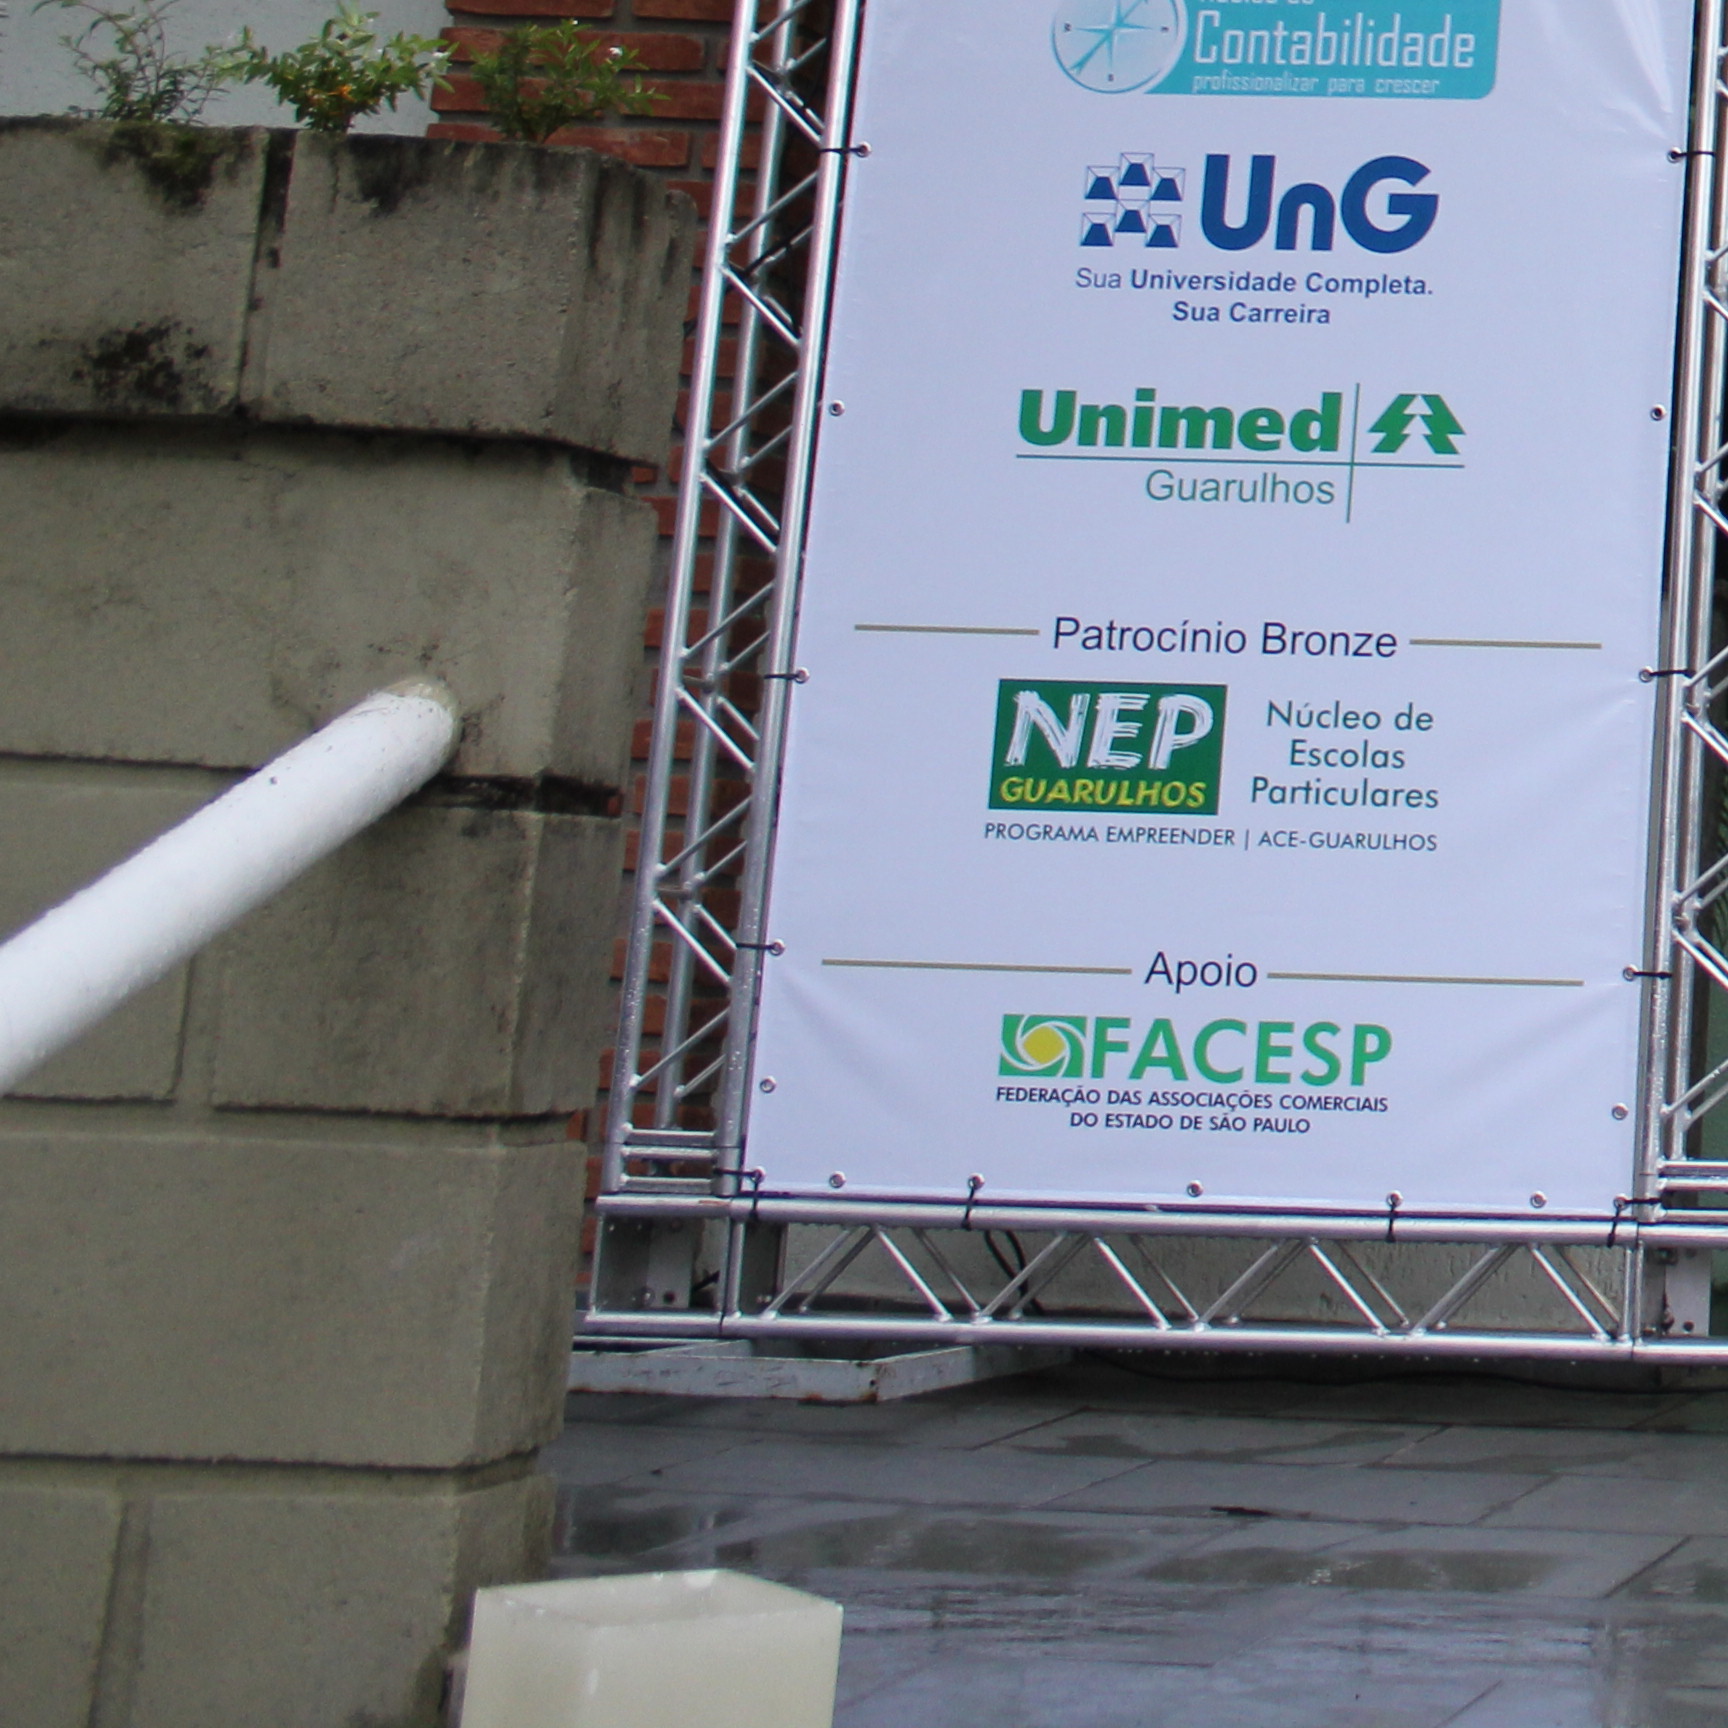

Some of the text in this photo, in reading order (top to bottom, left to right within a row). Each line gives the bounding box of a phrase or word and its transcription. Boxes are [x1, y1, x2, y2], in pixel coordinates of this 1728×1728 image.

[1193, 10, 1475, 68] Contabilidade
[1191, 69, 1441, 96] profissionalizar para crescer
[1200, 153, 1440, 254] UnG
[1075, 267, 1434, 299] Sua Universidade Completa.
[1172, 300, 1331, 325] Sua Carreira
[1018, 387, 1343, 453] Unimed
[1145, 469, 1336, 506] Guarulhos
[1052, 616, 1399, 658] Patrocínio Bronze
[1003, 689, 1215, 772] NEP
[1266, 698, 1435, 732] Núcleo de
[1289, 738, 1406, 771] Escolas
[1000, 776, 1208, 809] GUARULHOS
[1250, 776, 1440, 810] Particulares
[984, 822, 1099, 843] PROGRAMA
[1106, 825, 1235, 846] EMPREENDER
[1257, 830, 1438, 851] ACE-GUARULHOS
[1144, 951, 1259, 994] Apoio
[1090, 1016, 1392, 1086] FACESP
[996, 1086, 1389, 1113] FEDERAÇÃO DAS ASSOCIAÇÕES COMERCIAIS
[1070, 1112, 1311, 1134] DO ESTADO DE SÃO PAULO
